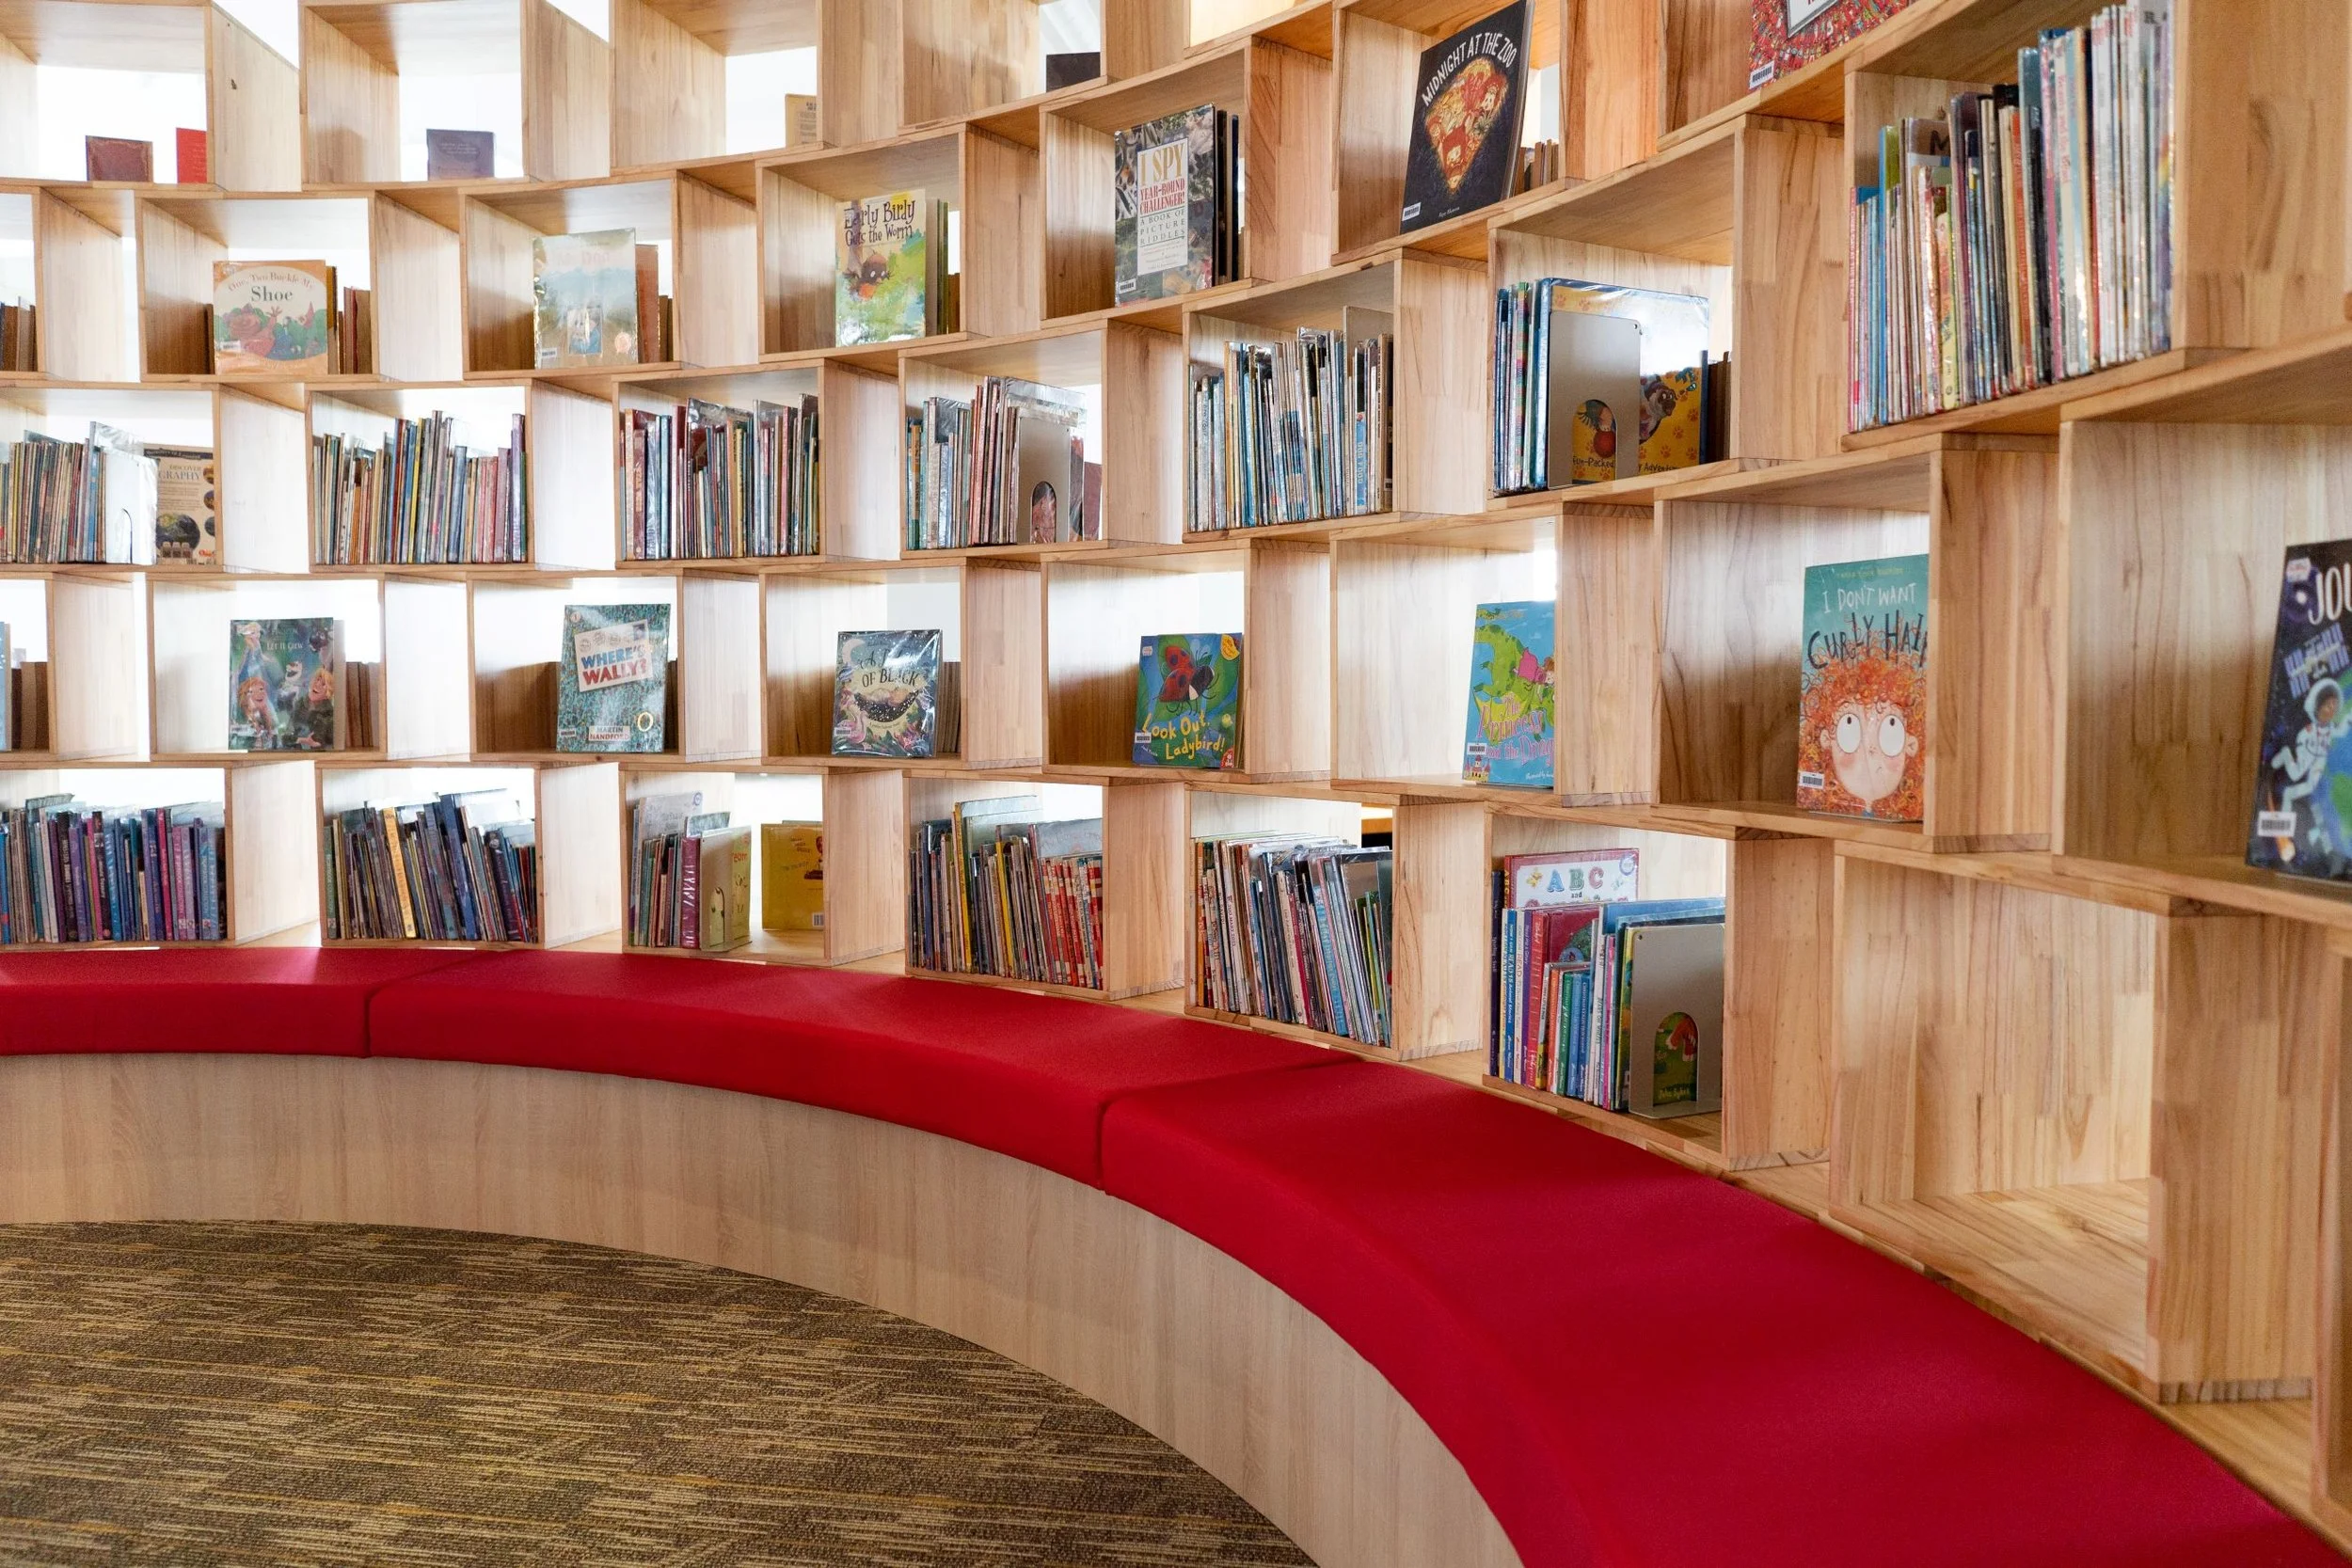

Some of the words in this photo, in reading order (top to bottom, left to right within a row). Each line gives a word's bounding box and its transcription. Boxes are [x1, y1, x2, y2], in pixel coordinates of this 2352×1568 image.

[1422, 41, 1468, 107] MIDNIGHT
[1467, 33, 1483, 57] AT
[1482, 32, 1503, 56] THE
[1500, 37, 1518, 69] ZOO
[1140, 153, 1146, 186] I
[1152, 143, 1185, 182] SPY
[1140, 177, 1185, 201] YEAR-ROUND
[844, 204, 879, 230] Early
[882, 199, 915, 225] Birdy
[1139, 192, 1185, 215] CHALLENGER!
[1140, 217, 1145, 227] A
[1148, 213, 1171, 224] BOOK
[1175, 208, 1185, 217] OF
[1140, 219, 1185, 236] PICTURE
[845, 229, 866, 247] Gets
[868, 225, 882, 244] the
[885, 223, 913, 240] Worm
[1140, 229, 1185, 245] RIDDLES
[251, 285, 293, 302] Shoe
[158, 470, 200, 480] GRAPHY
[1822, 591, 1831, 613] I
[1837, 584, 1876, 611] DON'T
[1878, 582, 1916, 606] WANT
[1807, 611, 1875, 670] CURLY
[580, 644, 646, 670] WHERE'S
[582, 658, 647, 686] WALLY?
[862, 672, 876, 688] OF
[1502, 691, 1520, 715] The
[1141, 712, 1177, 740] Look
[1476, 705, 1545, 740] Princess
[1166, 734, 1226, 760] Ladybird!
[1518, 735, 1554, 768] Drag
